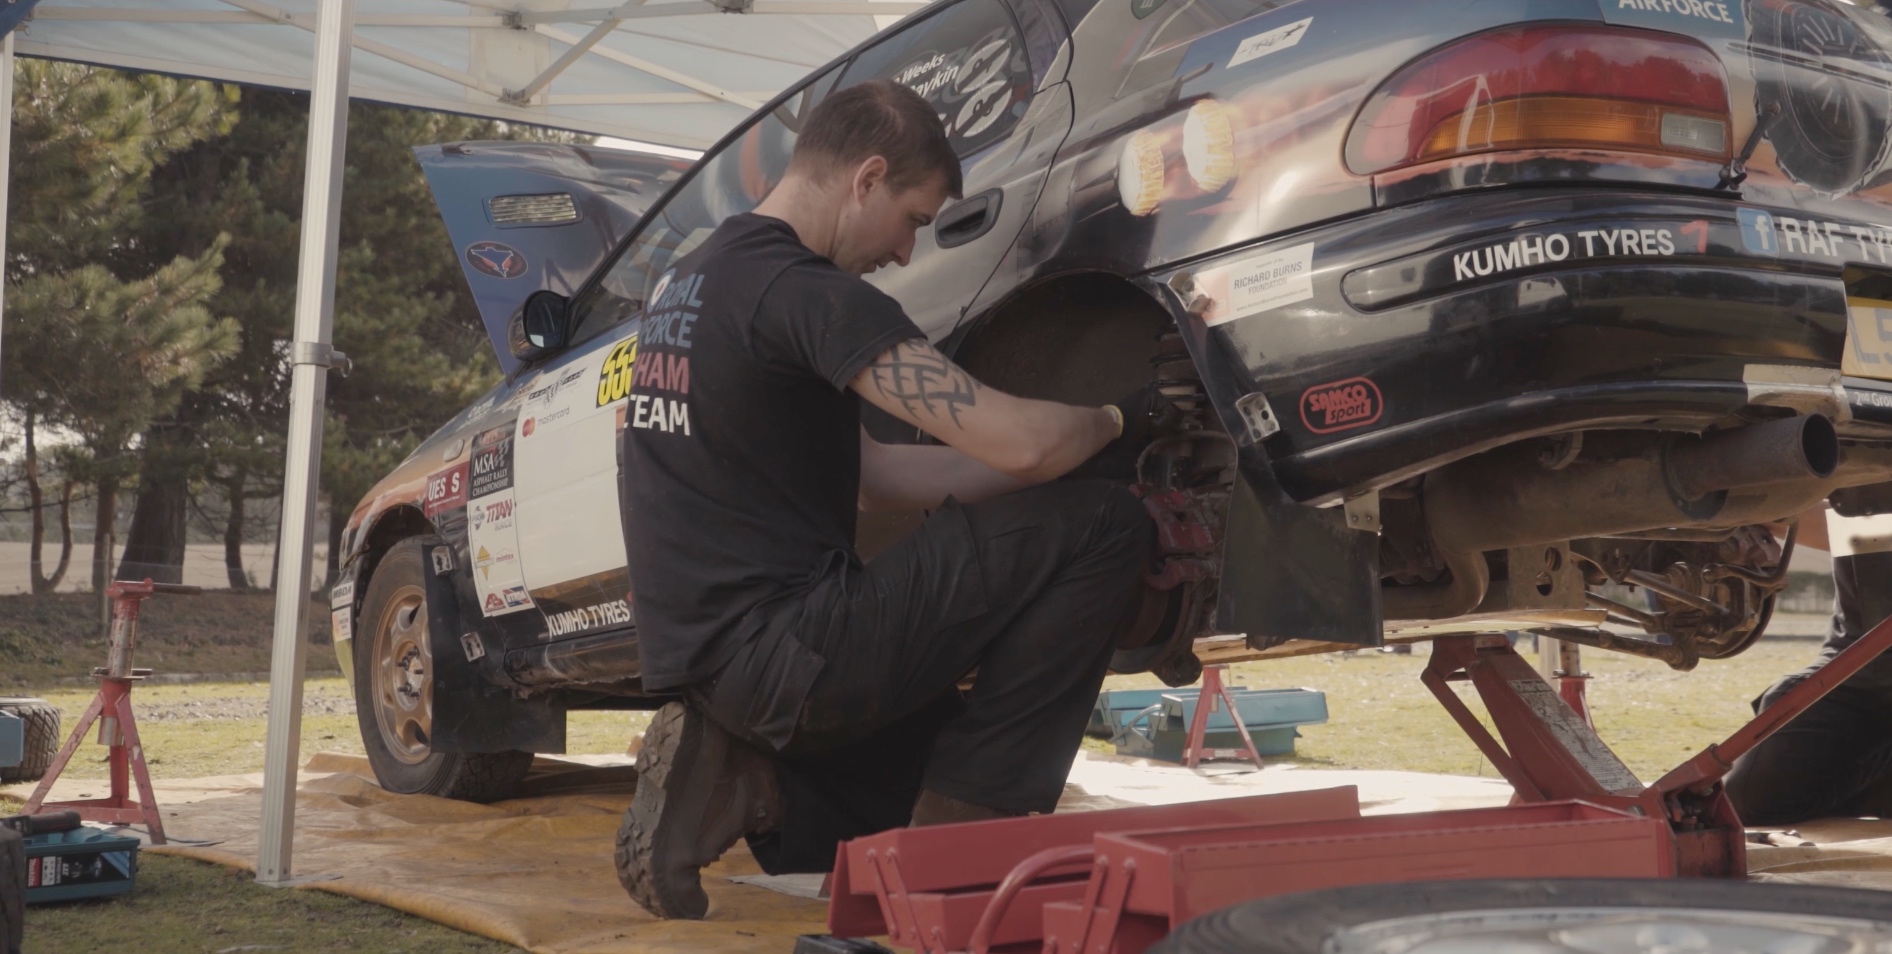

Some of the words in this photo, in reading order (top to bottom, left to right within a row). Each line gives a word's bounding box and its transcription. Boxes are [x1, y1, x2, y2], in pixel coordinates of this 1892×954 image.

[902, 53, 946, 84] Weeks
[1780, 216, 1844, 257] RAF
[1453, 233, 1570, 281] KUMHO
[1578, 228, 1675, 257] TYRES
[1233, 270, 1271, 290] RICHARD
[1273, 261, 1303, 278] BURNS
[1248, 276, 1288, 295] FOUNDATION
[633, 352, 690, 394] HAM
[1308, 385, 1368, 412] SAMCO
[538, 407, 570, 426] mastercard
[1331, 401, 1366, 423] sport
[473, 452, 495, 477] MSA
[428, 477, 446, 502] UES
[472, 477, 509, 497] CHAMPIONSHIP
[486, 499, 513, 524] TITAN
[496, 553, 515, 563] mintex
[545, 607, 591, 639] KUMHO
[587, 599, 631, 628] TYRES
